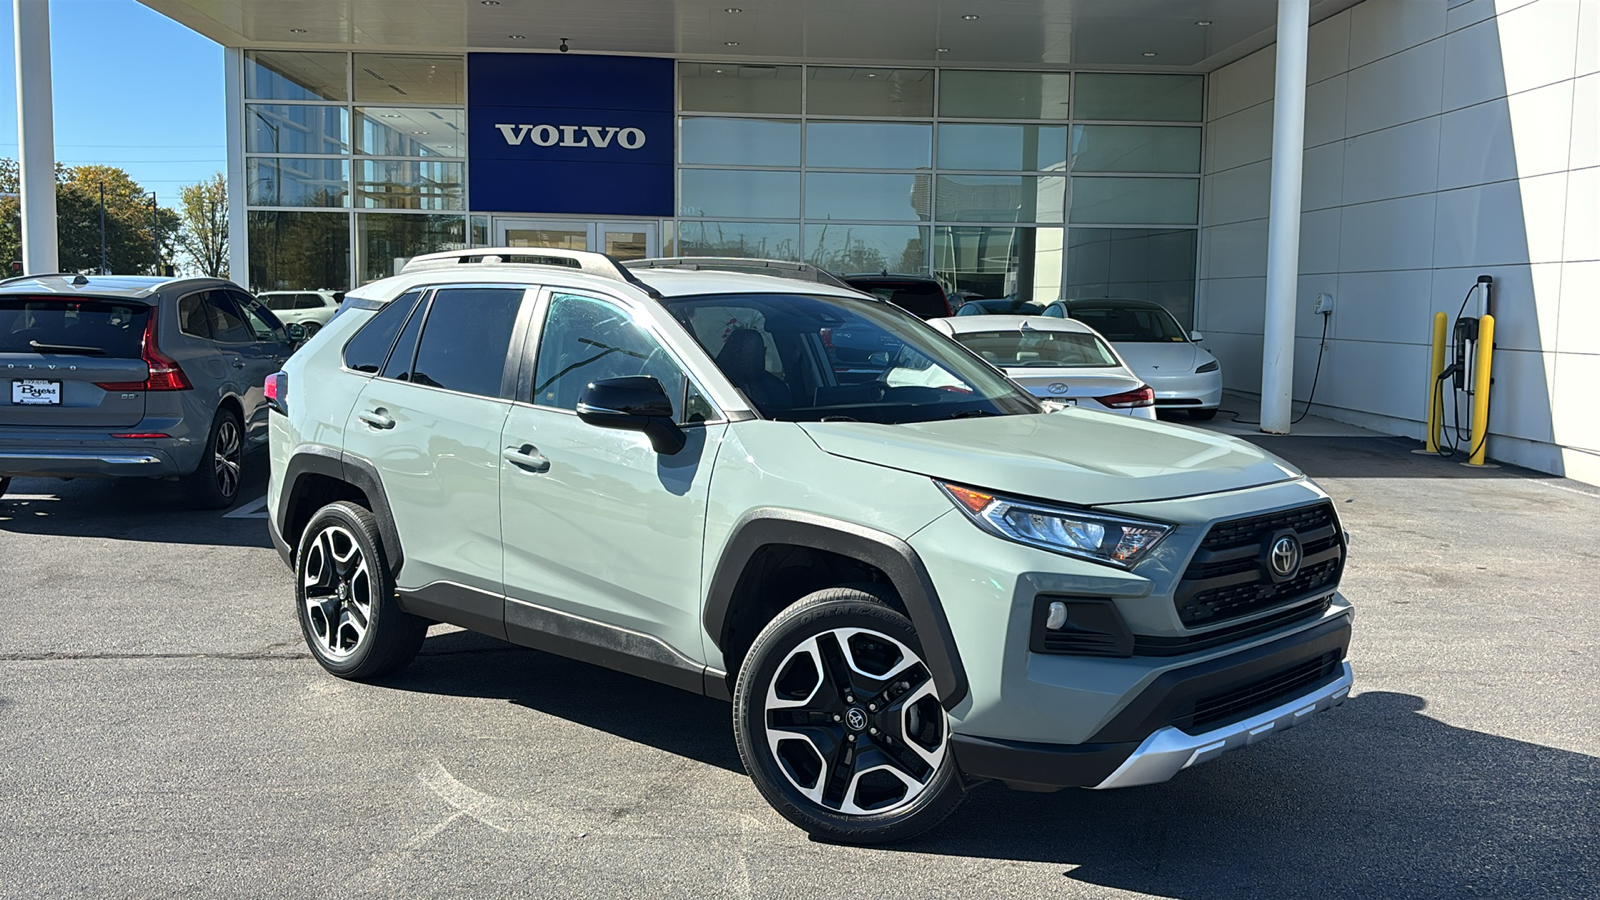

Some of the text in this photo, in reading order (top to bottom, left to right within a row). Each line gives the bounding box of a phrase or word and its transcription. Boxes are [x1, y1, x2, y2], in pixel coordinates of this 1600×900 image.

[495, 124, 646, 149] VOLVO
[681, 239, 709, 249] Cars
[17, 384, 56, 397] Byers
[800, 606, 852, 625] OPEN
